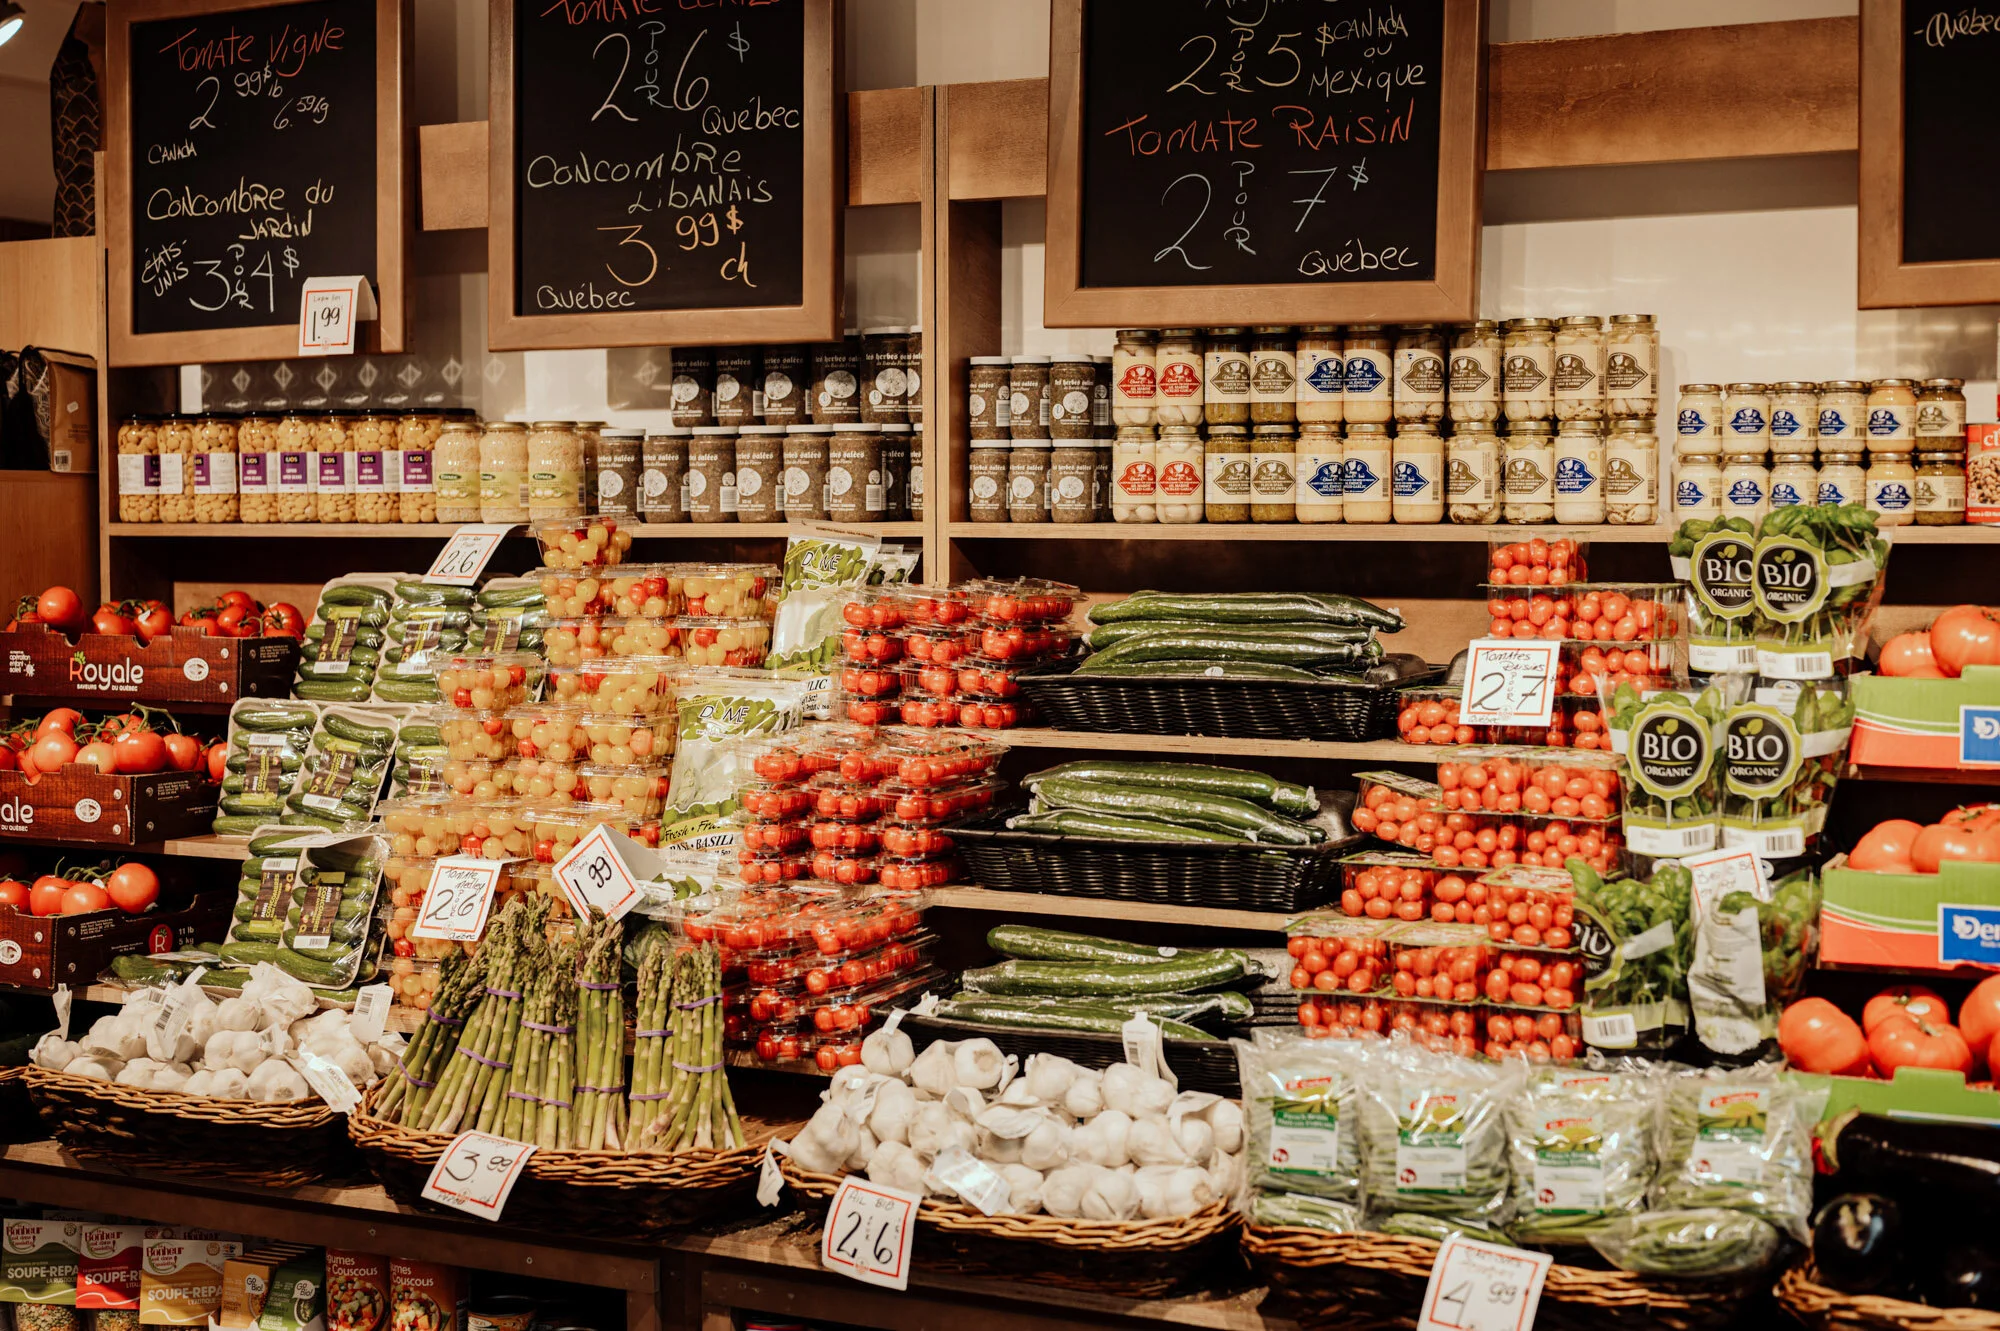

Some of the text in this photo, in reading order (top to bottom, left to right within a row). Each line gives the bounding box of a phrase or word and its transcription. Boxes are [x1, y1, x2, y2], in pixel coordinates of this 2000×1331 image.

[592, 33, 639, 121] 2
[673, 29, 709, 111] 6
[1166, 35, 1217, 94] 2
[1256, 33, 1302, 87] 5
[190, 76, 220, 129] 2
[702, 97, 800, 135] Québec
[305, 178, 335, 204] du
[1154, 173, 1213, 270] 2
[1288, 167, 1339, 233] 7
[1298, 238, 1419, 276] Québec
[189, 260, 231, 312] 3
[537, 282, 635, 309] Québec
[1705, 558, 1752, 582] BIO
[1761, 562, 1811, 587] BIO
[1711, 588, 1752, 598] ORGANIC
[1766, 591, 1807, 602] ORGANIC
[69, 656, 144, 691] Royale
[1471, 672, 1505, 711] 2
[1515, 675, 1547, 710] 7
[1642, 733, 1697, 759] BIO
[1728, 733, 1783, 760] BIO
[1645, 766, 1693, 778] ORGANIC
[1730, 766, 1779, 778] ORGANIC
[426, 889, 454, 920] 2
[457, 893, 477, 917] 6
[836, 1211, 893, 1265] 2 6
